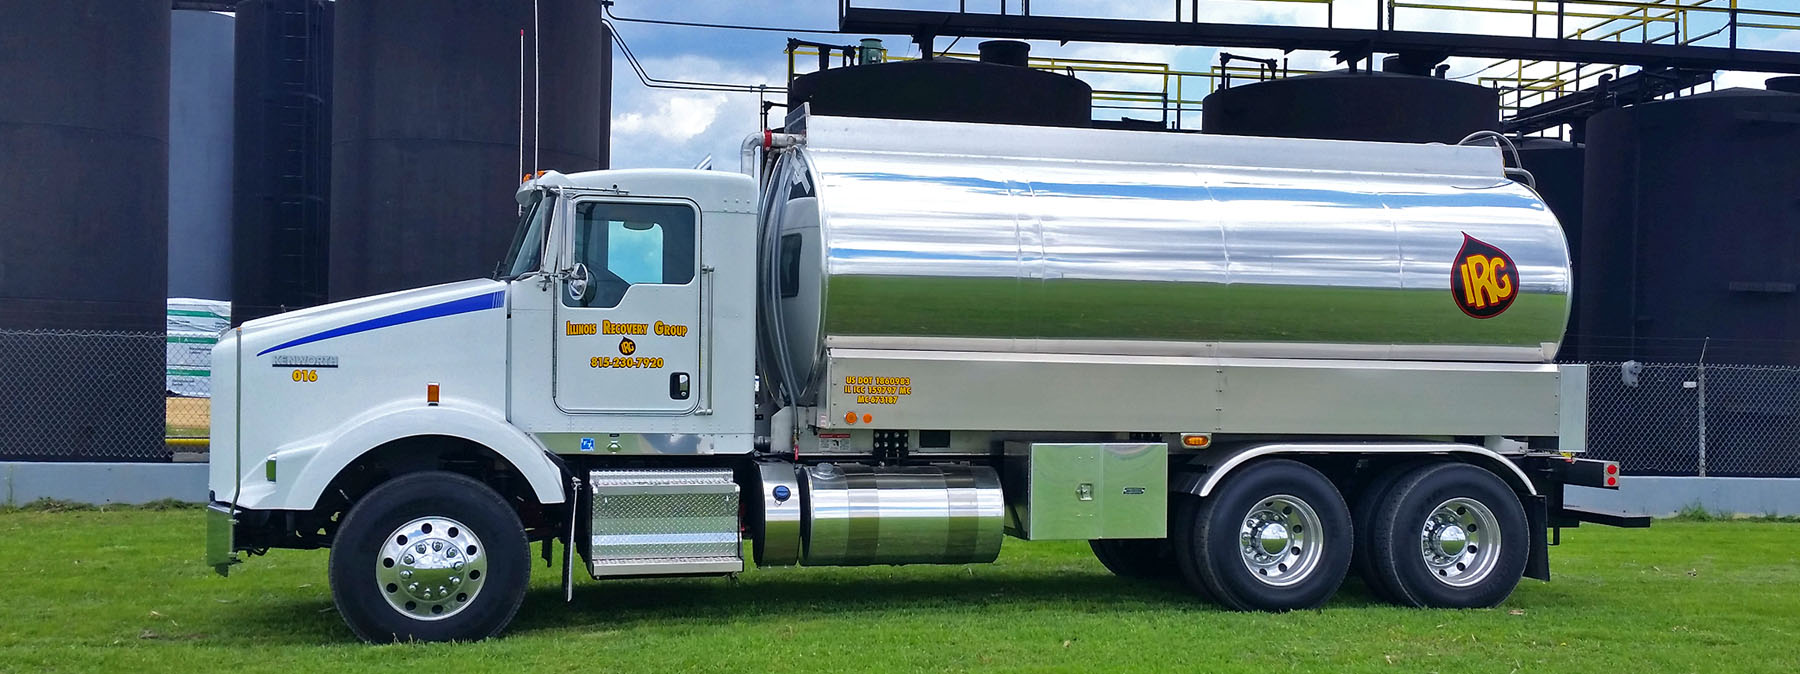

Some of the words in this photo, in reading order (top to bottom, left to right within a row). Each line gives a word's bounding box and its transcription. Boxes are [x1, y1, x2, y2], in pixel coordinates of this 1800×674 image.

[1461, 254, 1512, 308] IRG
[566, 320, 597, 336] ILLINOIS
[602, 319, 648, 335] RECOVERY
[654, 320, 688, 337] GROUP
[621, 341, 635, 354] IRG
[590, 356, 664, 369] 815-230-7920
[292, 369, 318, 382] 016
[846, 376, 856, 384] US
[857, 376, 873, 385] DOT
[875, 377, 910, 386] 1860983
[844, 385, 851, 394] IL
[853, 386, 865, 394] ICC
[868, 386, 897, 395] 159797
[899, 387, 911, 395] MC
[857, 396, 898, 404] MC-673187
